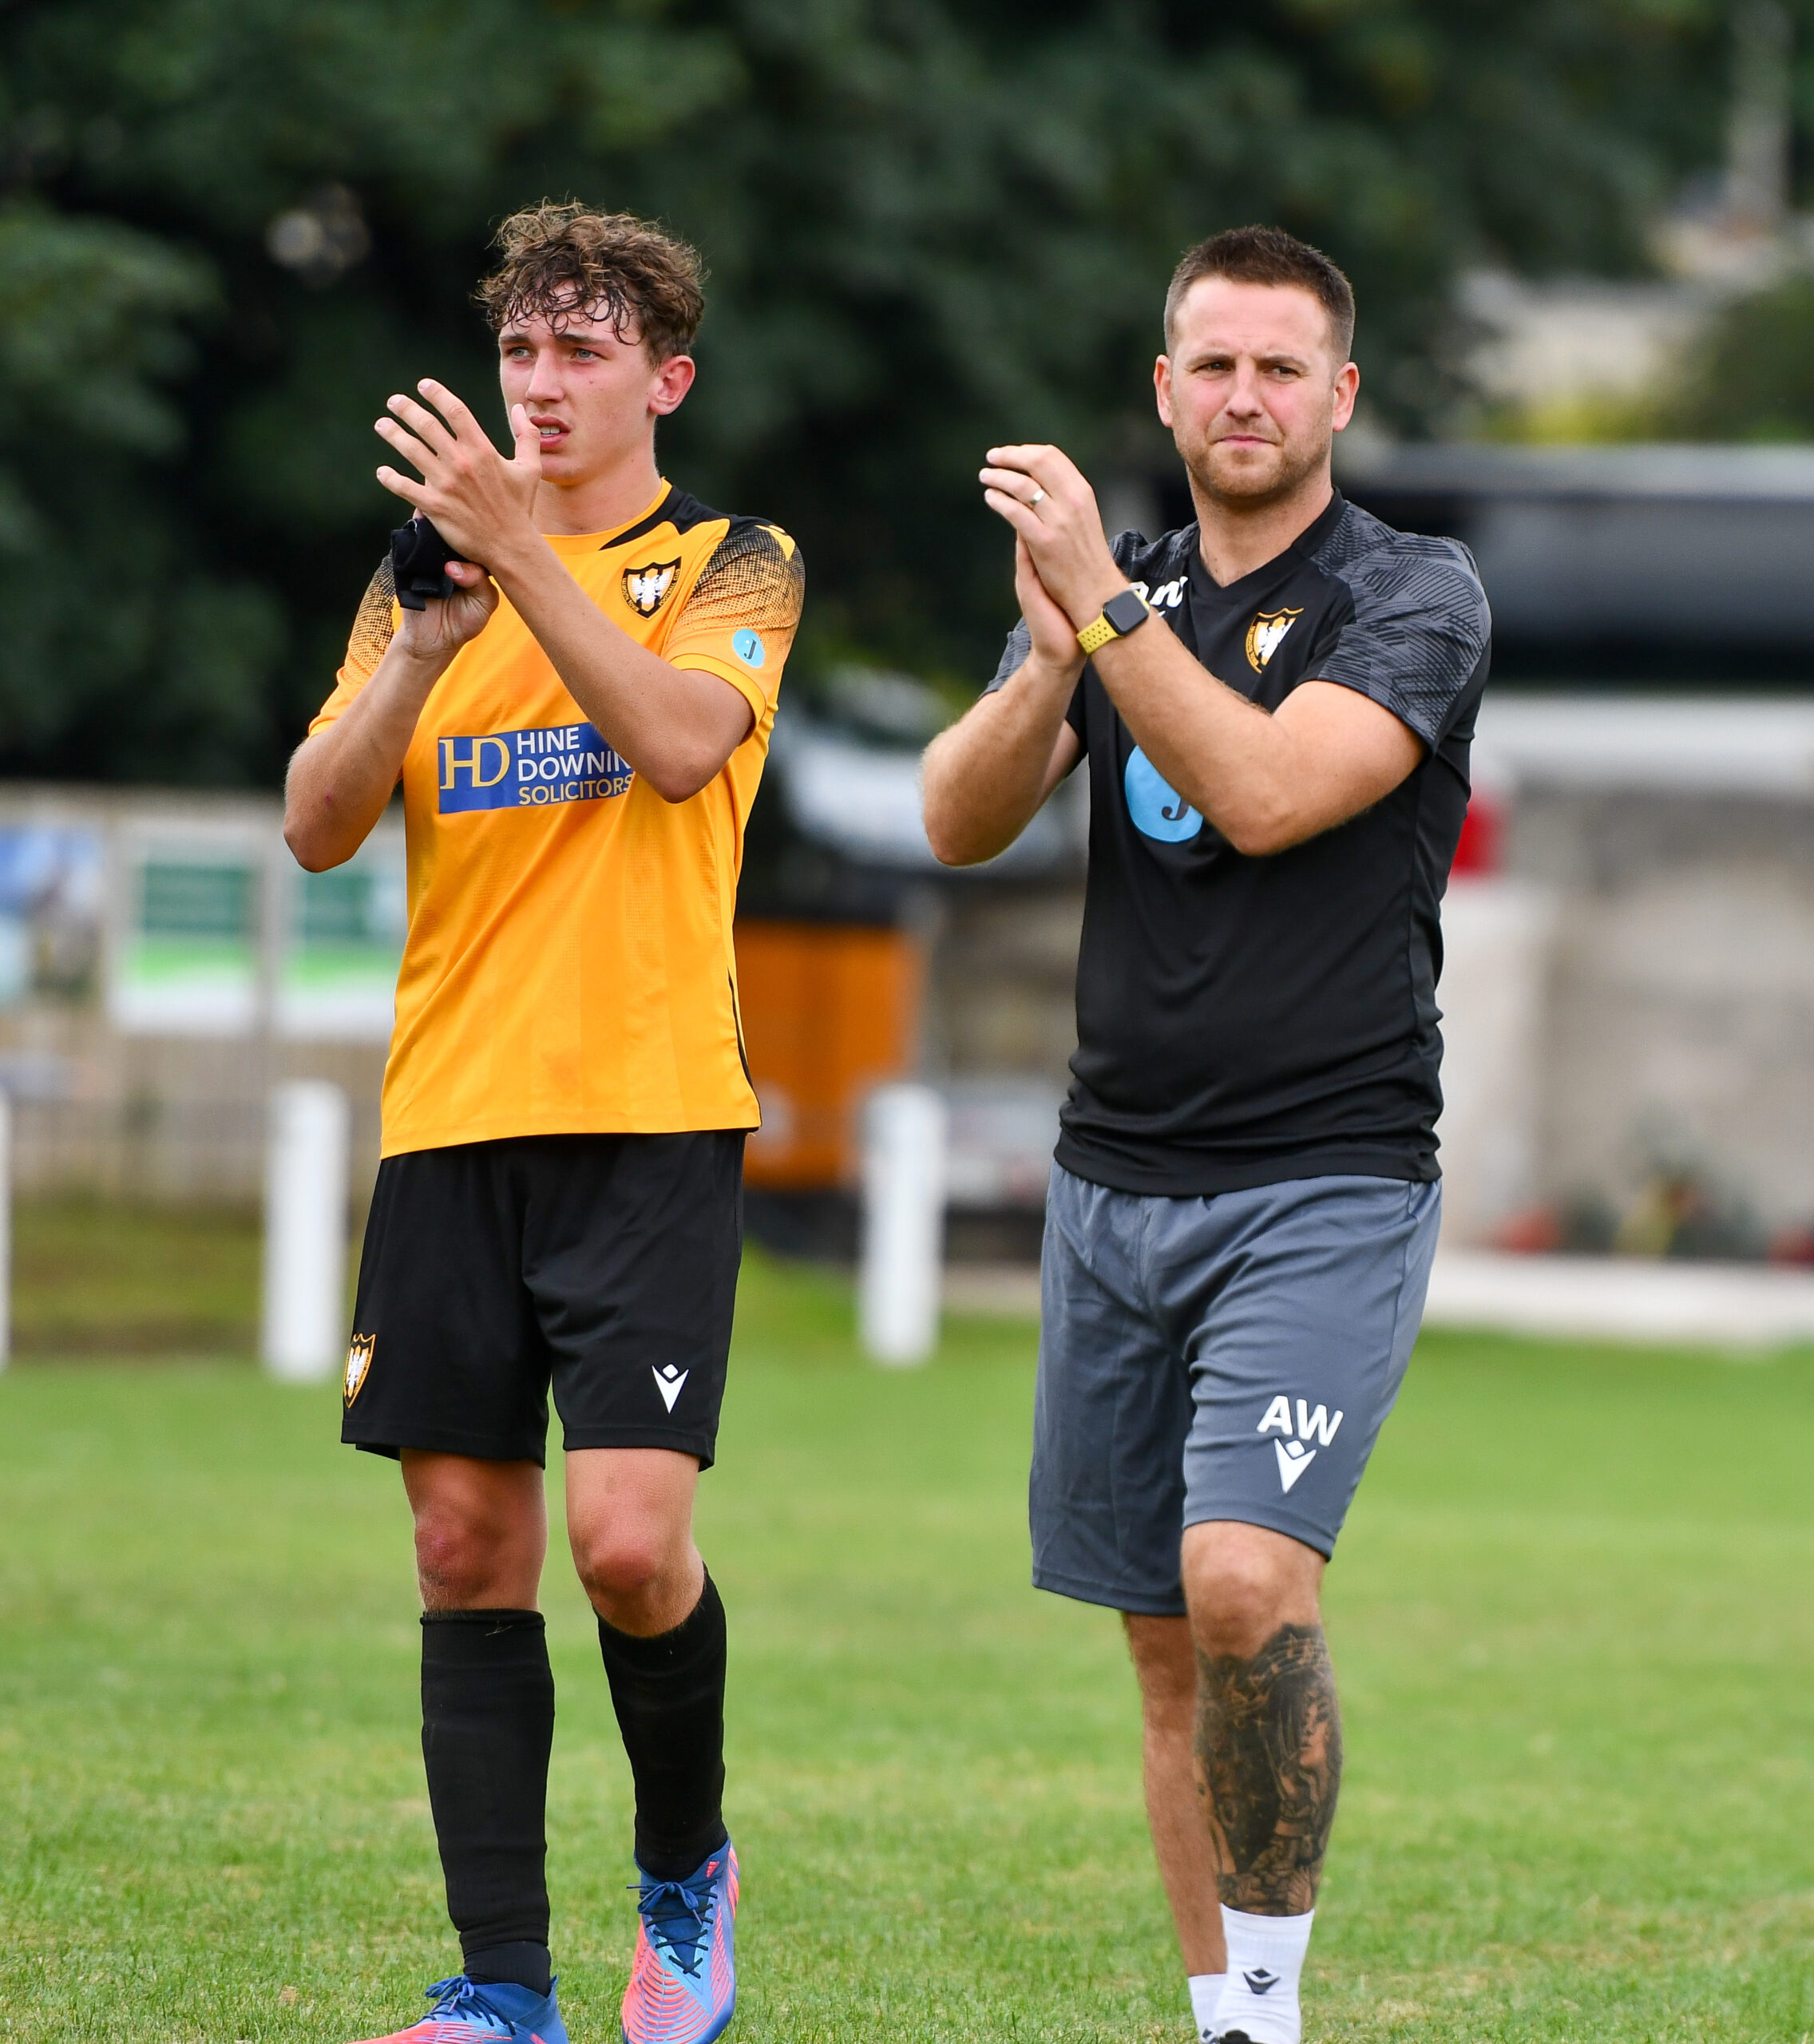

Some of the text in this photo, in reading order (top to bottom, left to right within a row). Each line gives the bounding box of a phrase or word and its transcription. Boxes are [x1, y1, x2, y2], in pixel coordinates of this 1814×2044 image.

[517, 727, 580, 755] HINE
[439, 737, 510, 790] HD
[518, 750, 632, 782] DOWNIN
[519, 774, 633, 806] SOLICITORS
[1257, 1395, 1344, 1447] AW
